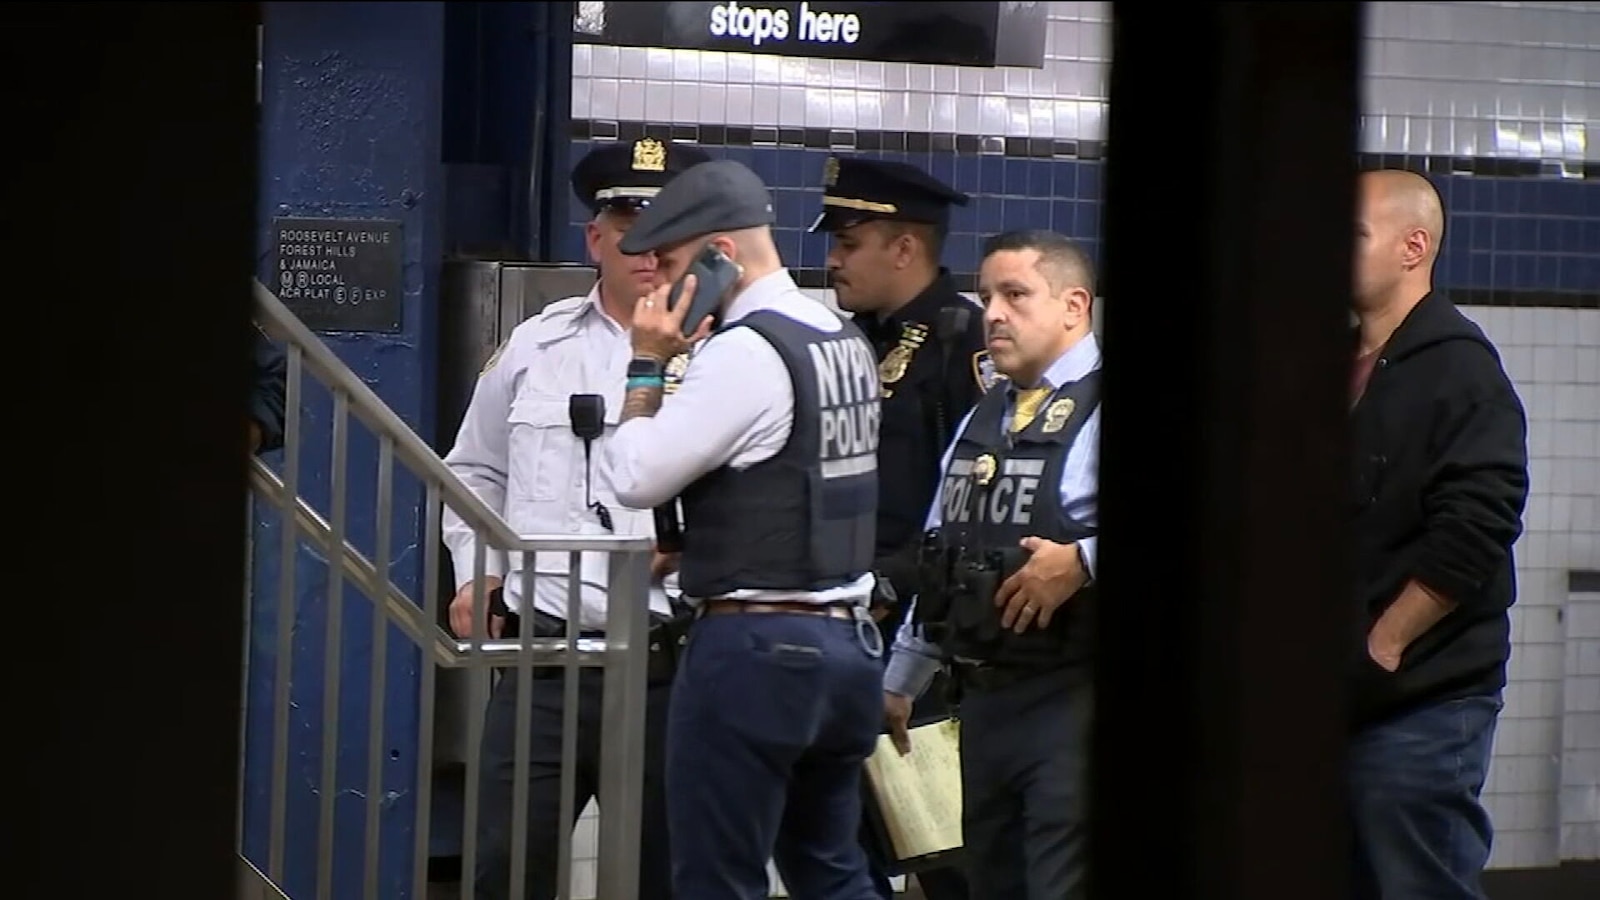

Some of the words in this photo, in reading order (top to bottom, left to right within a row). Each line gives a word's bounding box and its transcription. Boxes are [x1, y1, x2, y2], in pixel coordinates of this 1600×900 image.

[709, 1, 790, 45] stops
[798, 1, 860, 43] here
[280, 230, 343, 242] ROOSEVELT
[346, 232, 390, 243] AVENUE
[280, 244, 322, 255] FOREST
[325, 246, 356, 257] HILLS
[280, 259, 286, 270] &
[289, 260, 336, 270] JAMAICA
[310, 274, 345, 285] LOCAL
[304, 289, 330, 299] PLAT
[808, 337, 878, 407] NYPD
[820, 401, 880, 458] POLIC
